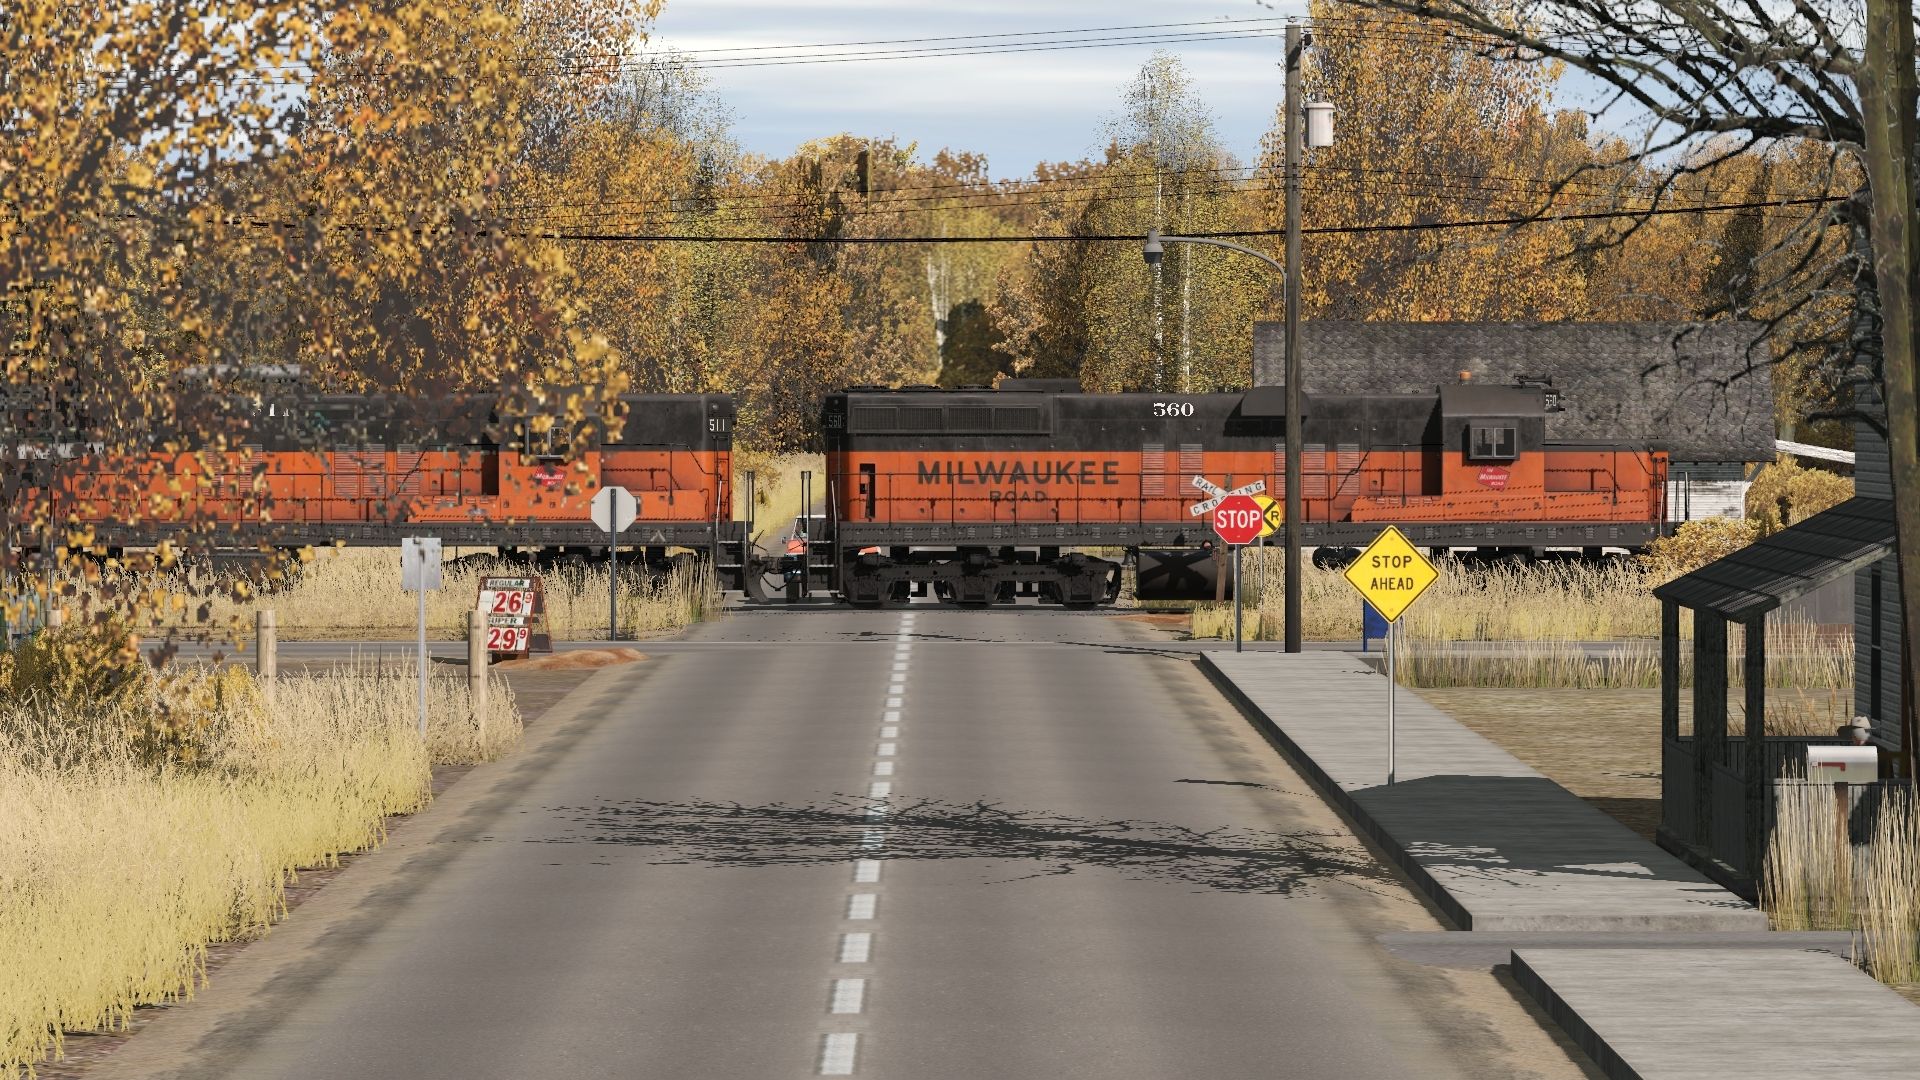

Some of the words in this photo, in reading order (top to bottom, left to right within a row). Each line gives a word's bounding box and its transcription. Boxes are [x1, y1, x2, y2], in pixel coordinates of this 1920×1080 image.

[1153, 402, 1195, 417] 560
[709, 418, 725, 432] 511
[828, 415, 842, 427] 560
[917, 461, 1120, 485] MILWAUKEE
[1195, 478, 1218, 496] RAIL
[989, 490, 1047, 503] ROAD
[1193, 482, 1262, 514] CROING
[1216, 509, 1261, 529] STOP
[1270, 510, 1280, 521] R
[1371, 555, 1413, 569] STOP
[488, 579, 525, 587] REGULAR
[1370, 577, 1414, 591] AHEAD
